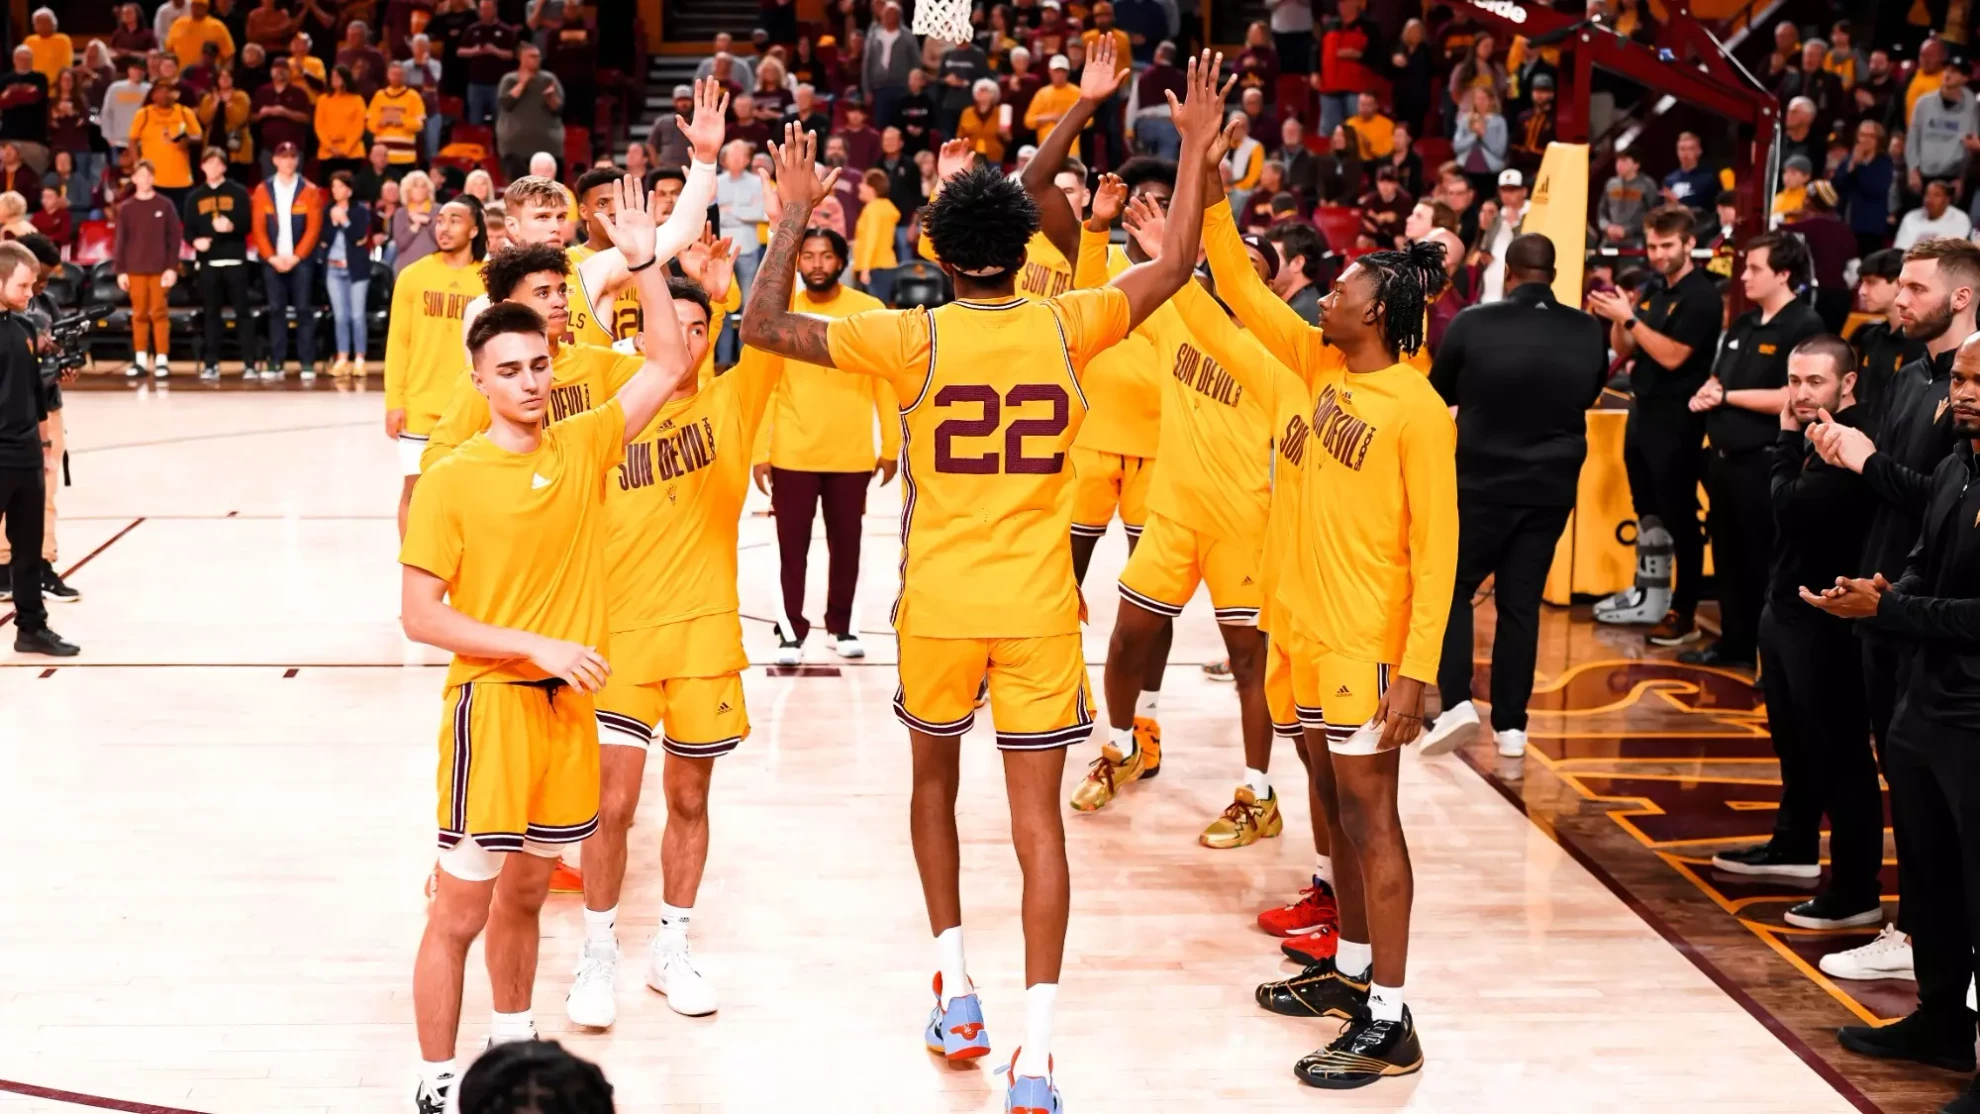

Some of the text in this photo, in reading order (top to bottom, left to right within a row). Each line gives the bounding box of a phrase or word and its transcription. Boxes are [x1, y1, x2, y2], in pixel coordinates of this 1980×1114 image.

[423, 290, 445, 317] SUN
[1022, 262, 1051, 296] SUN
[1173, 342, 1235, 405] SUN DEVIL
[617, 422, 711, 491] SUN DEVIL
[934, 384, 1069, 474] 22
[1323, 405, 1368, 469] DEVIL
